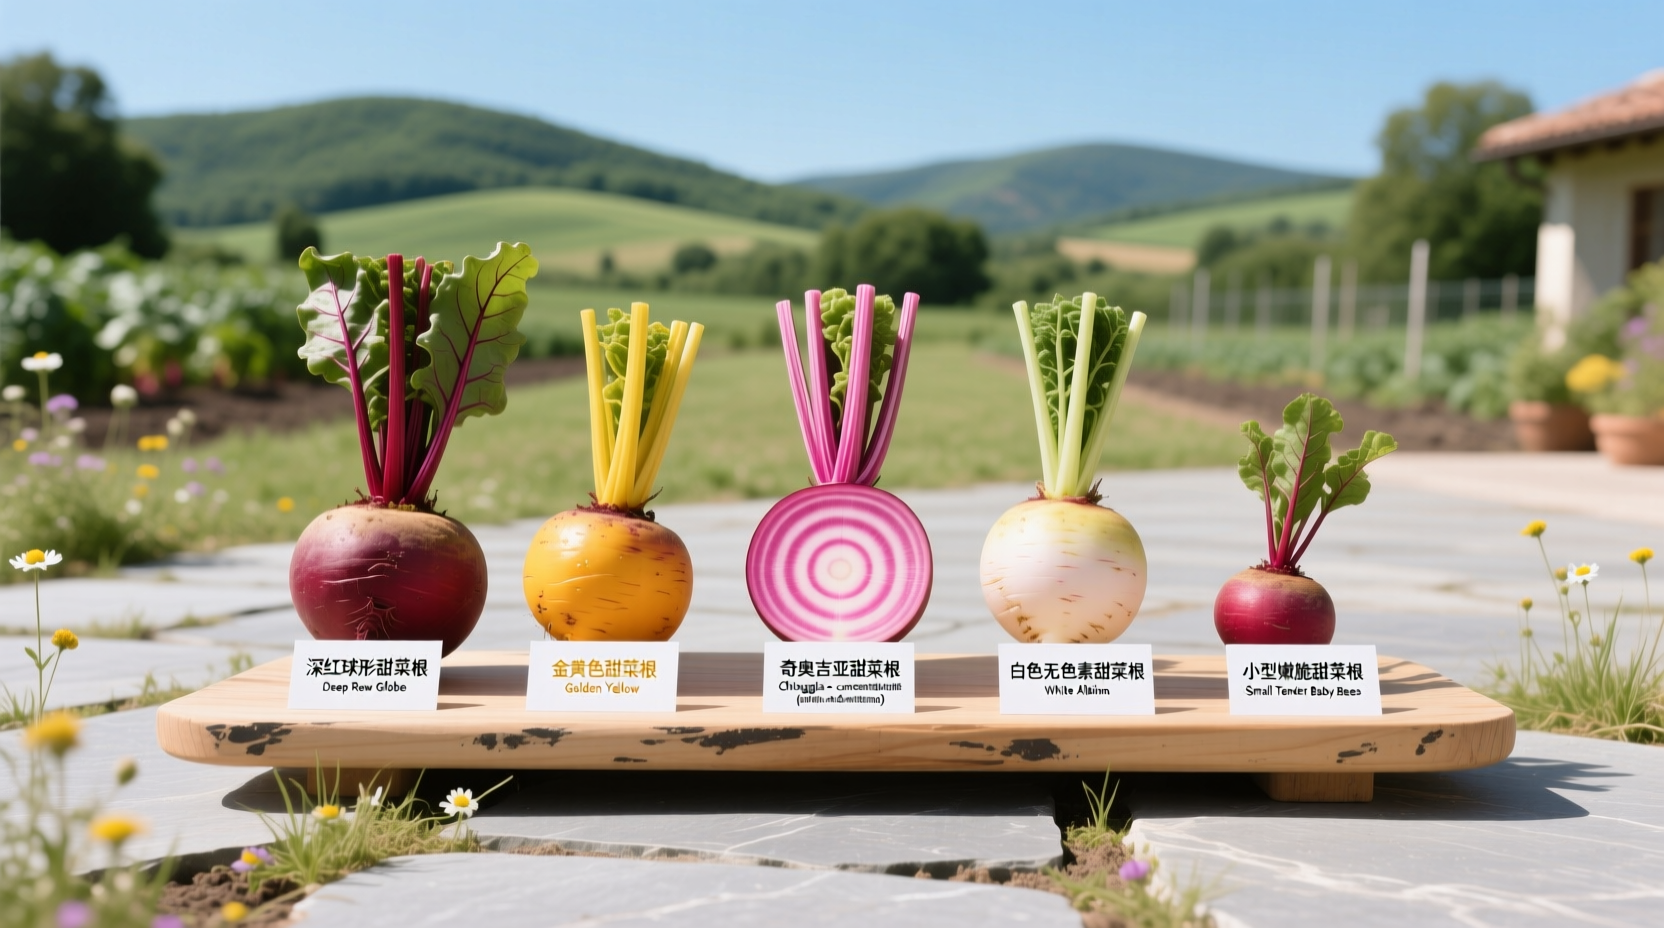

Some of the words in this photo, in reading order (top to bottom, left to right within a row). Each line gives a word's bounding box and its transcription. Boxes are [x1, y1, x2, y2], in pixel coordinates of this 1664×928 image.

[306, 657, 428, 677] 深红球形甜菜根
[552, 658, 657, 679] 金黄色甜菜根
[779, 658, 901, 679] 奇奥吉亚甜菜根
[1010, 661, 1145, 681] 白色无色素甜菜根
[1242, 661, 1365, 681] 小型嫩脆甜菜根
[322, 682, 348, 695] Deep
[351, 682, 373, 692] Rew
[376, 681, 407, 692] Globe
[1044, 684, 1074, 695] White
[1245, 685, 1273, 696] Small
[1310, 685, 1335, 698] Baby
